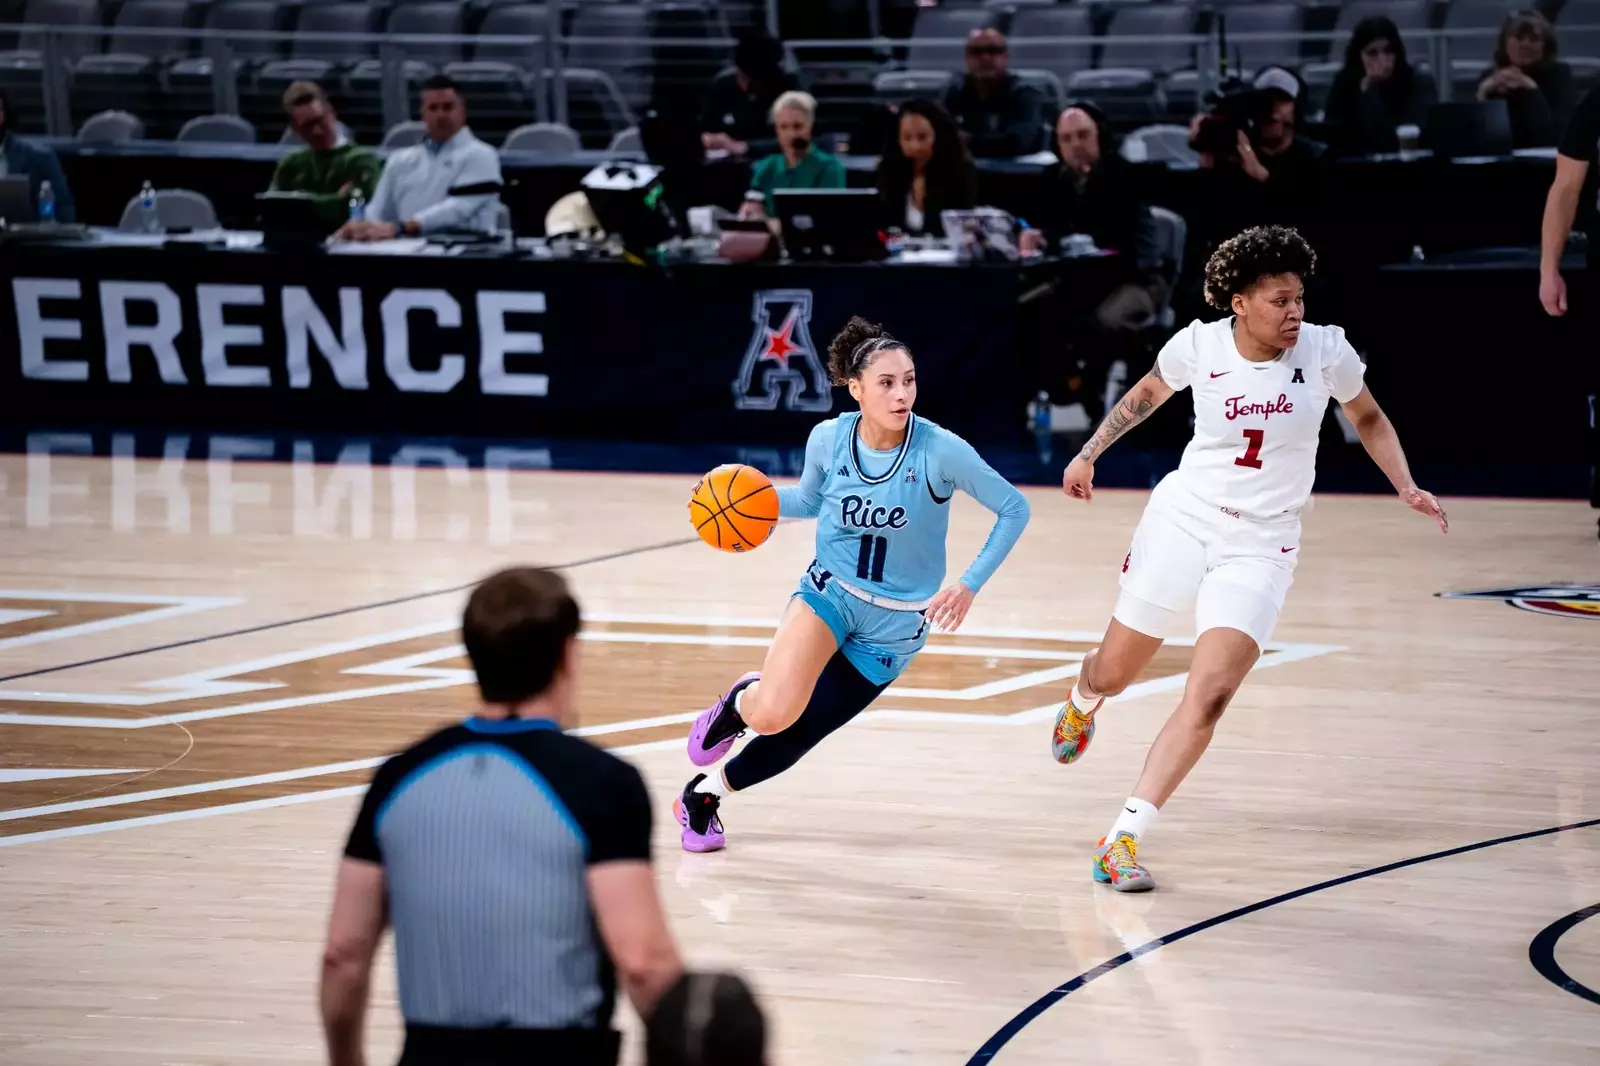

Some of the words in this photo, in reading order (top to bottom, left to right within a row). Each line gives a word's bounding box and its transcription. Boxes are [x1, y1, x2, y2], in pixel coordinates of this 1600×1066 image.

[12, 278, 549, 396] ERENCE
[1225, 393, 1294, 421] Temple
[1234, 429, 1264, 470] 1
[841, 494, 909, 529] Rice
[856, 534, 887, 583] 11
